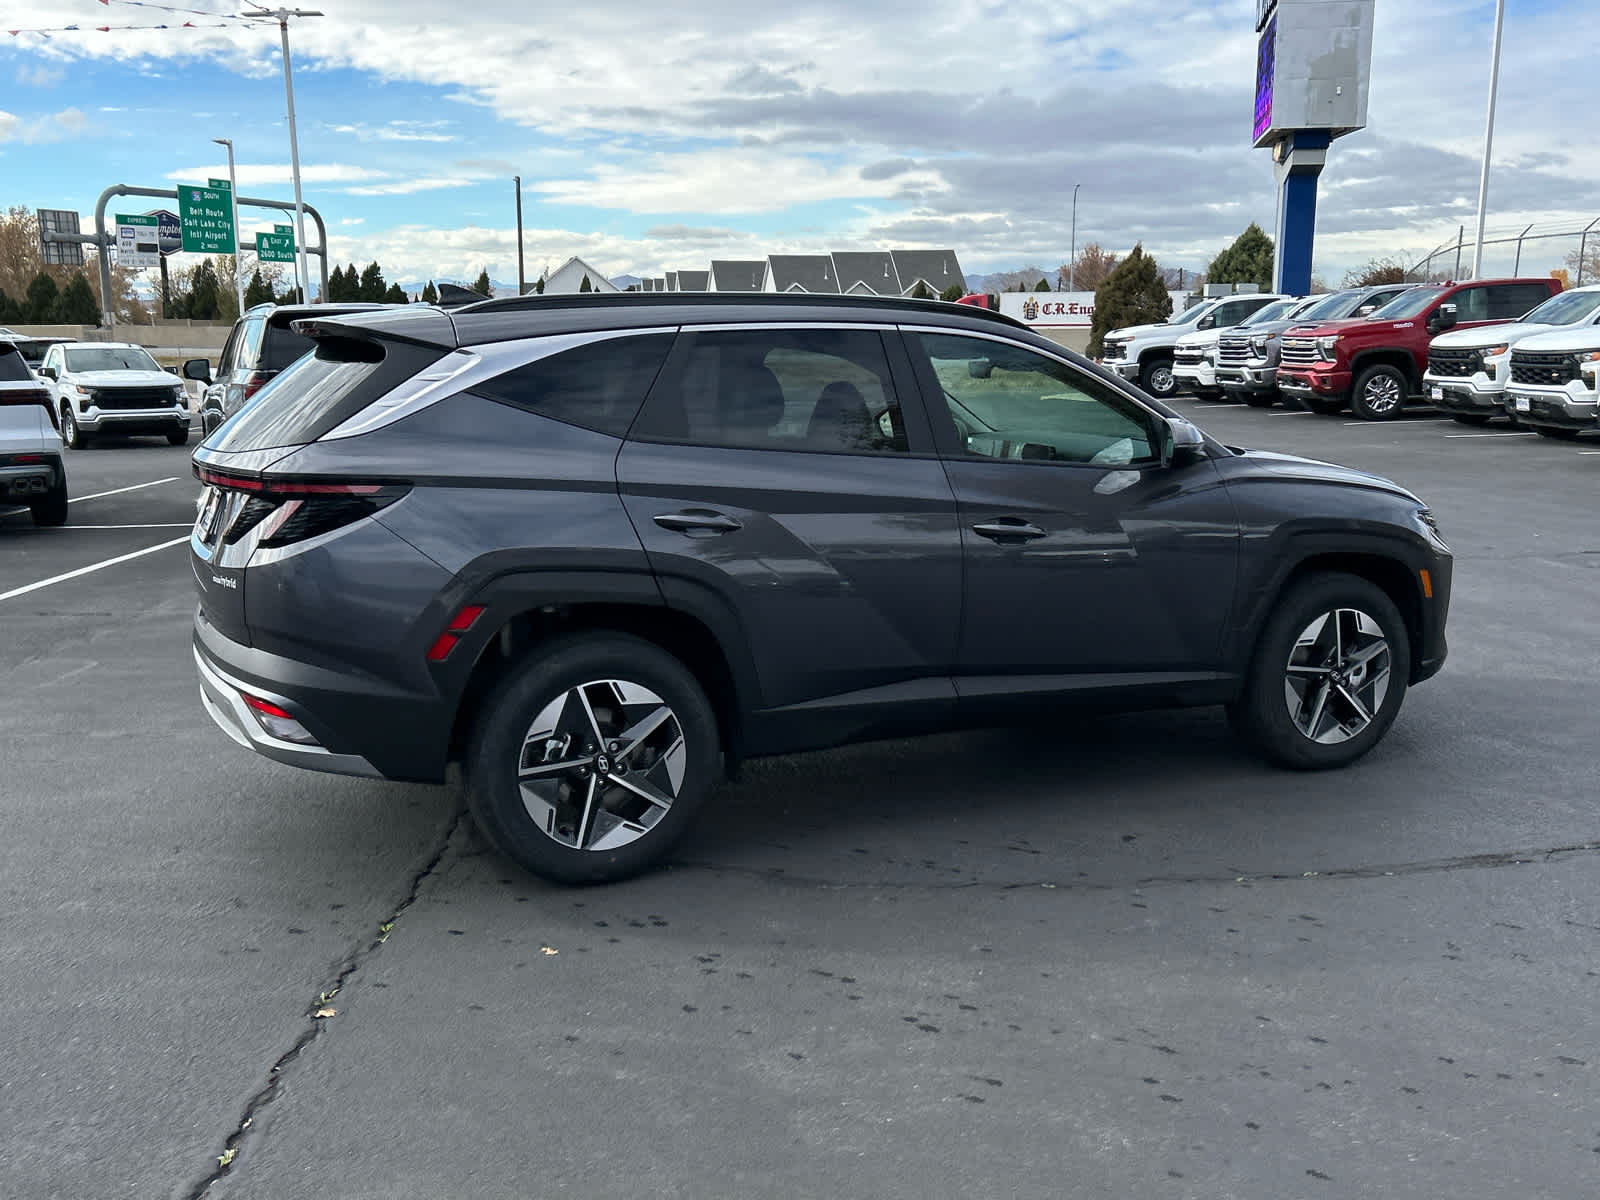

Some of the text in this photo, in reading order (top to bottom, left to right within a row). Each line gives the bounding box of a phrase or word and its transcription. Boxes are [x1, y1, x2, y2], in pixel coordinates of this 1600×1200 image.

[189, 207, 224, 217] Belt Route
[184, 218, 230, 230] Salt Lake City
[205, 231, 227, 240] Airport
[260, 249, 275, 258] 2600
